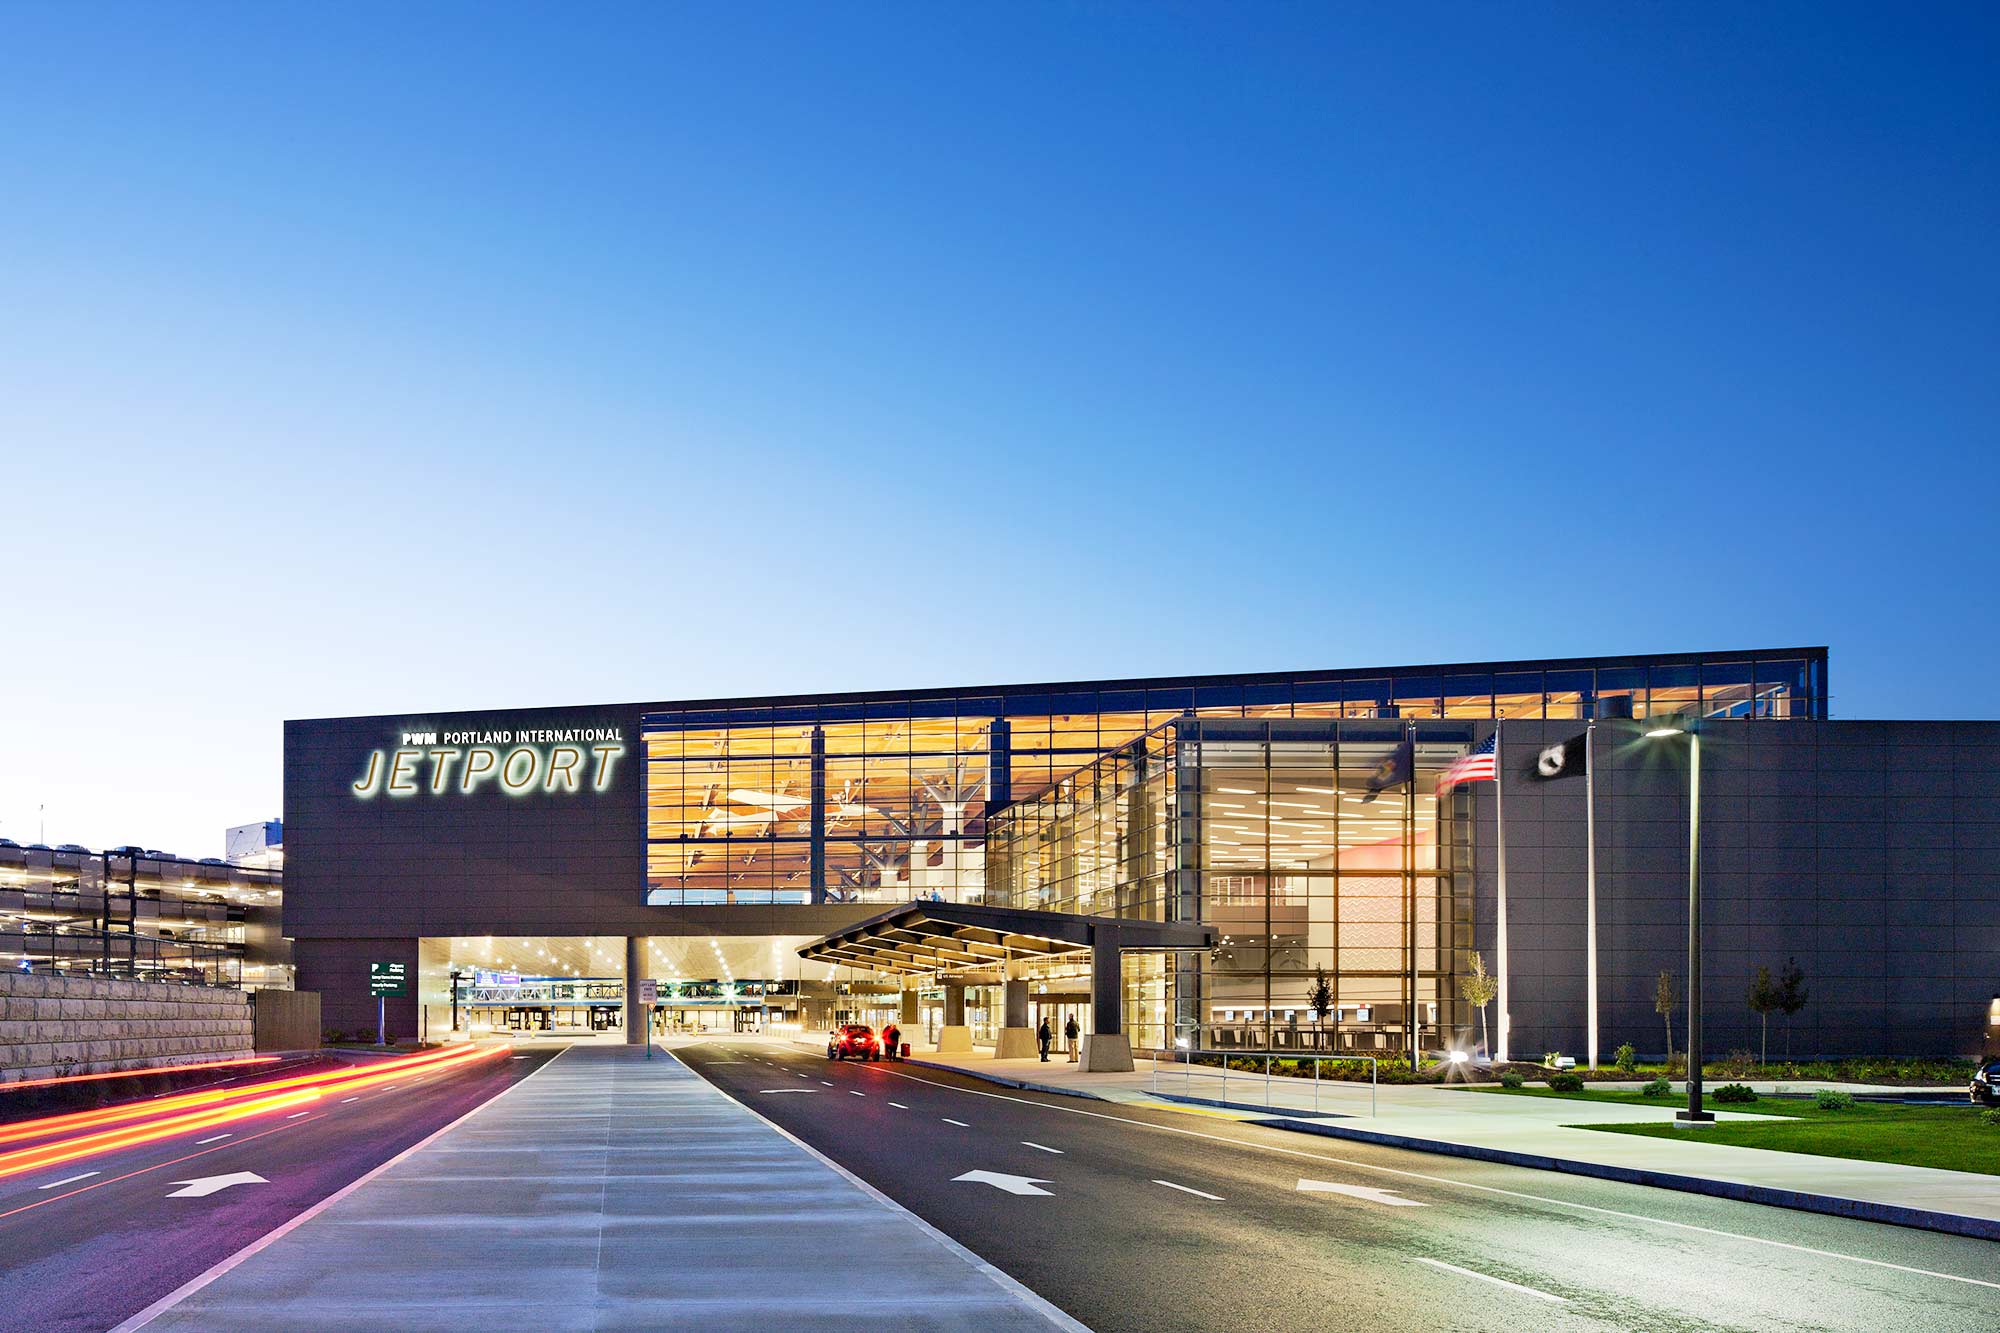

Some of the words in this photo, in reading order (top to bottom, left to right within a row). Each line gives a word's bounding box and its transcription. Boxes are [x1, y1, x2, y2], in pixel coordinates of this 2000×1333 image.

[402, 732, 437, 746] PWM
[443, 731, 512, 745] PORTLAND
[515, 728, 623, 744] INTERNATIONAL
[353, 746, 623, 792] JETPORT
